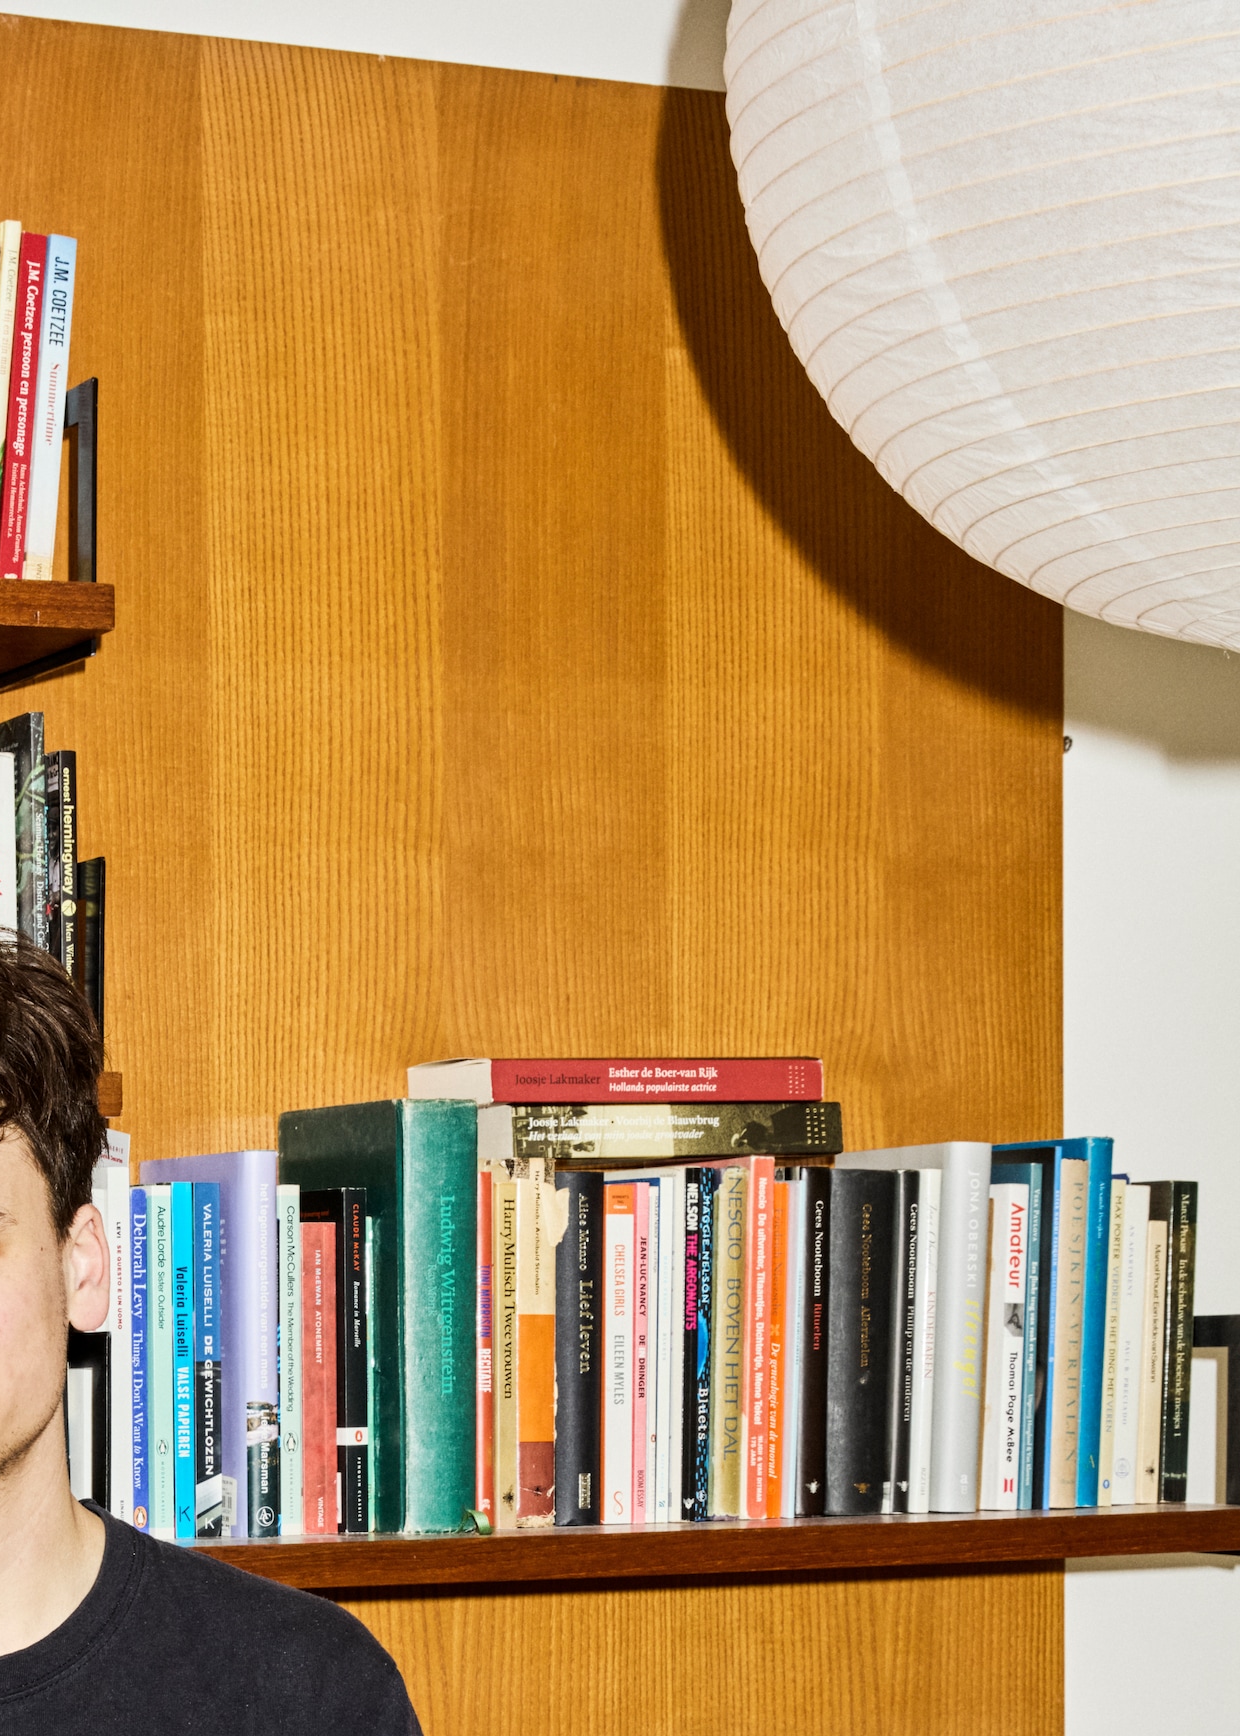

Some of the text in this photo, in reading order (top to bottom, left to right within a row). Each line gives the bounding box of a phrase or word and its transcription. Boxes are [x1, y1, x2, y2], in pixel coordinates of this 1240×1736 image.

[62, 766, 73, 895] ernest hemingway
[608, 1066, 719, 1081] Esther de Boer-van Rijk
[608, 1081, 717, 1095] Hollands populairste actrice
[352, 1204, 360, 1238] CLAUDE
[814, 1199, 824, 1296] Cees Nooteboom
[132, 1213, 147, 1320] Deborah Levy
[314, 1249, 322, 1264] IAN
[314, 1310, 322, 1364] ATONEMENT
[1004, 1352, 1018, 1463] Thomas Page McBee
